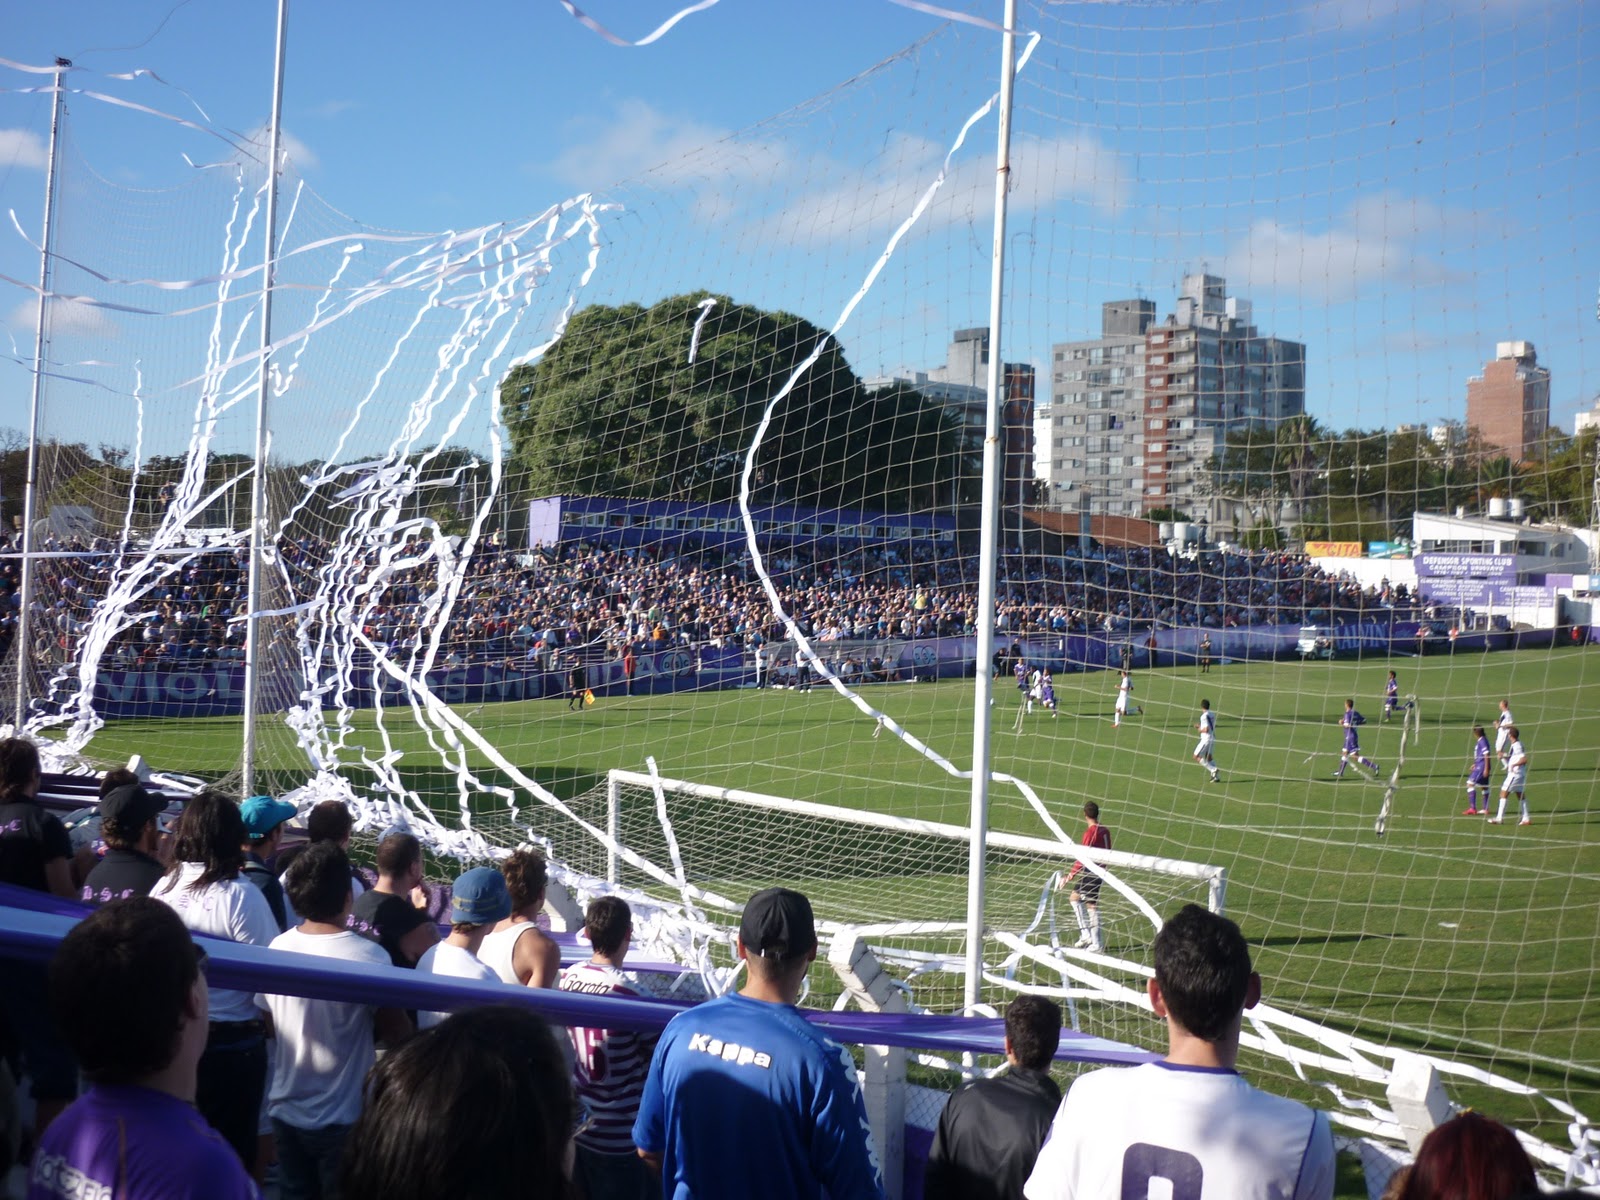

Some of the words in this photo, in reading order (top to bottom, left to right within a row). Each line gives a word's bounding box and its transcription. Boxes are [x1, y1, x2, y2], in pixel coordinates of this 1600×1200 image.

[1327, 543, 1360, 557] CITA
[1423, 556, 1459, 565] DEFENSOR
[1461, 557, 1493, 566] SPORTING
[1494, 557, 1513, 567] CLUB
[687, 1032, 772, 1069] Kappa
